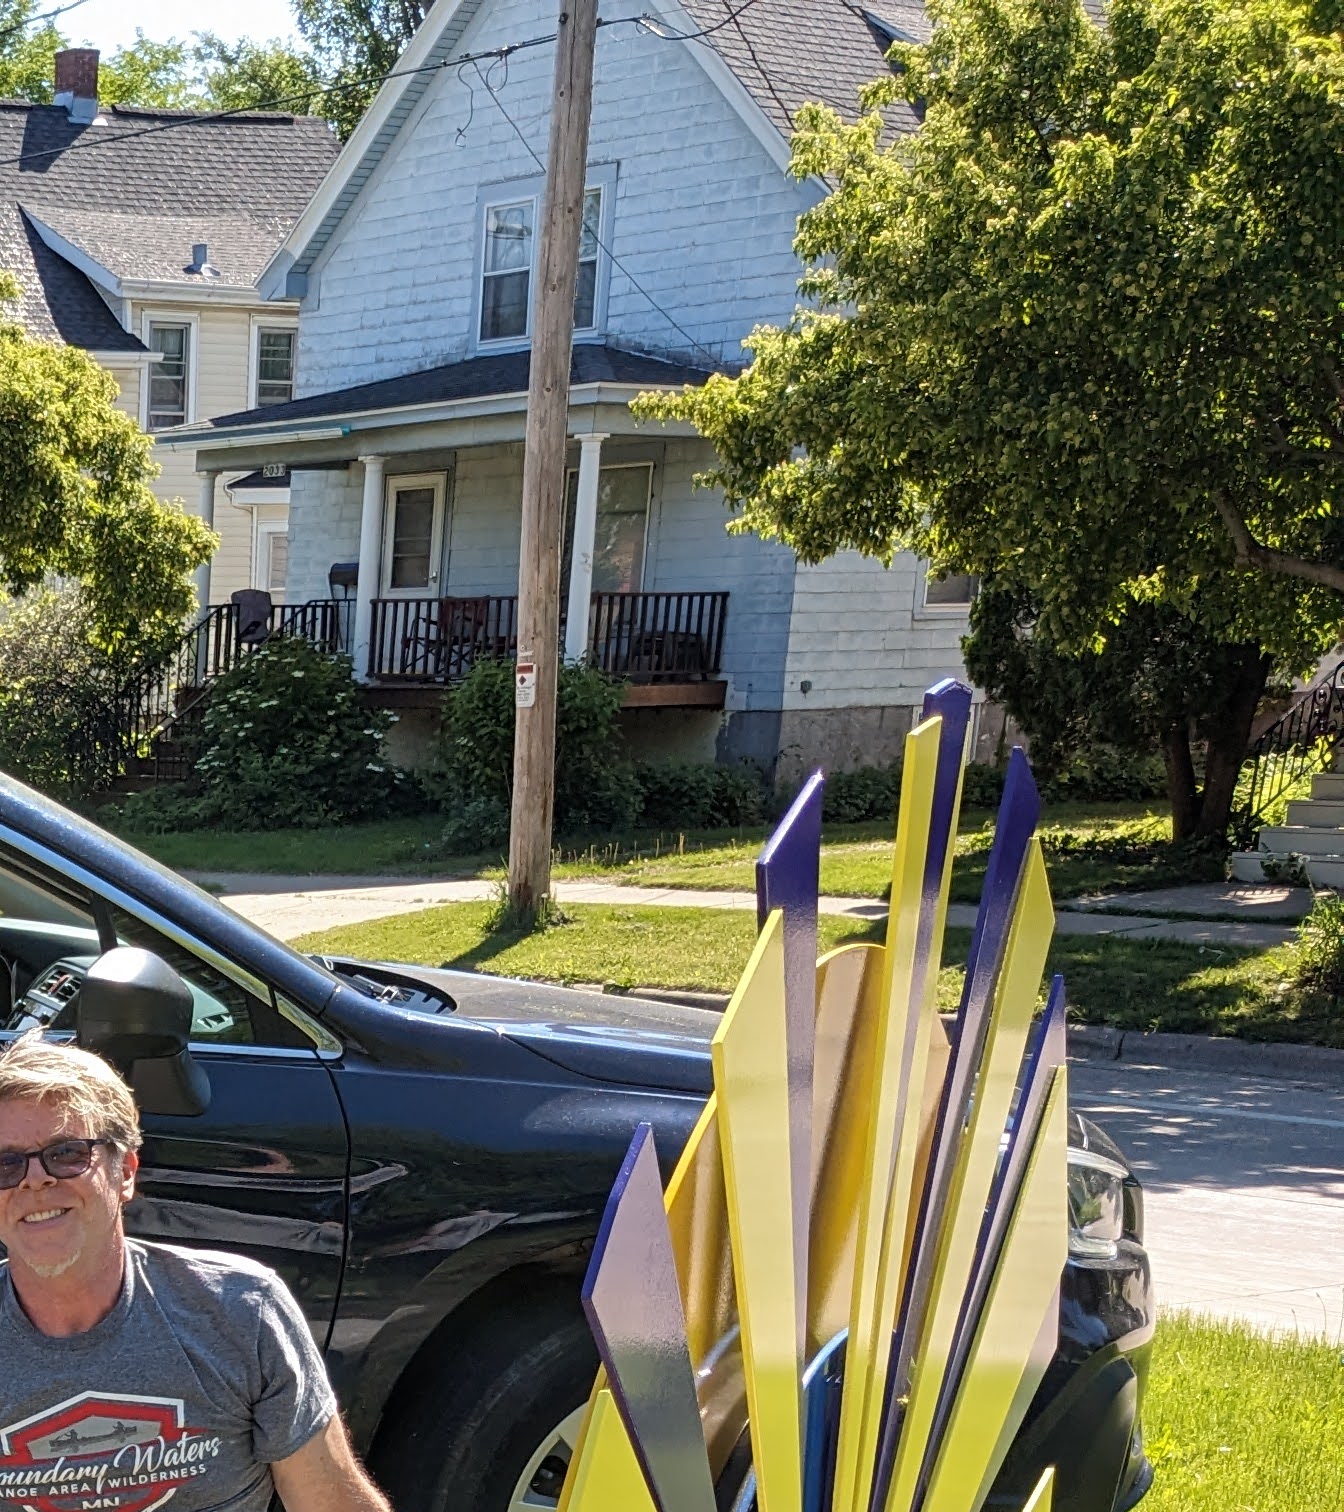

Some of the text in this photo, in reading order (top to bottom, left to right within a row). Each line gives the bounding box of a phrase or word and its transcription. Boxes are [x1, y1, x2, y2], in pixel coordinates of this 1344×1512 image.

[113, 1432, 223, 1475] Waters
[49, 1482, 92, 1496] AREA
[108, 1463, 208, 1488] WILDERNESS
[82, 1496, 120, 1510] MN
